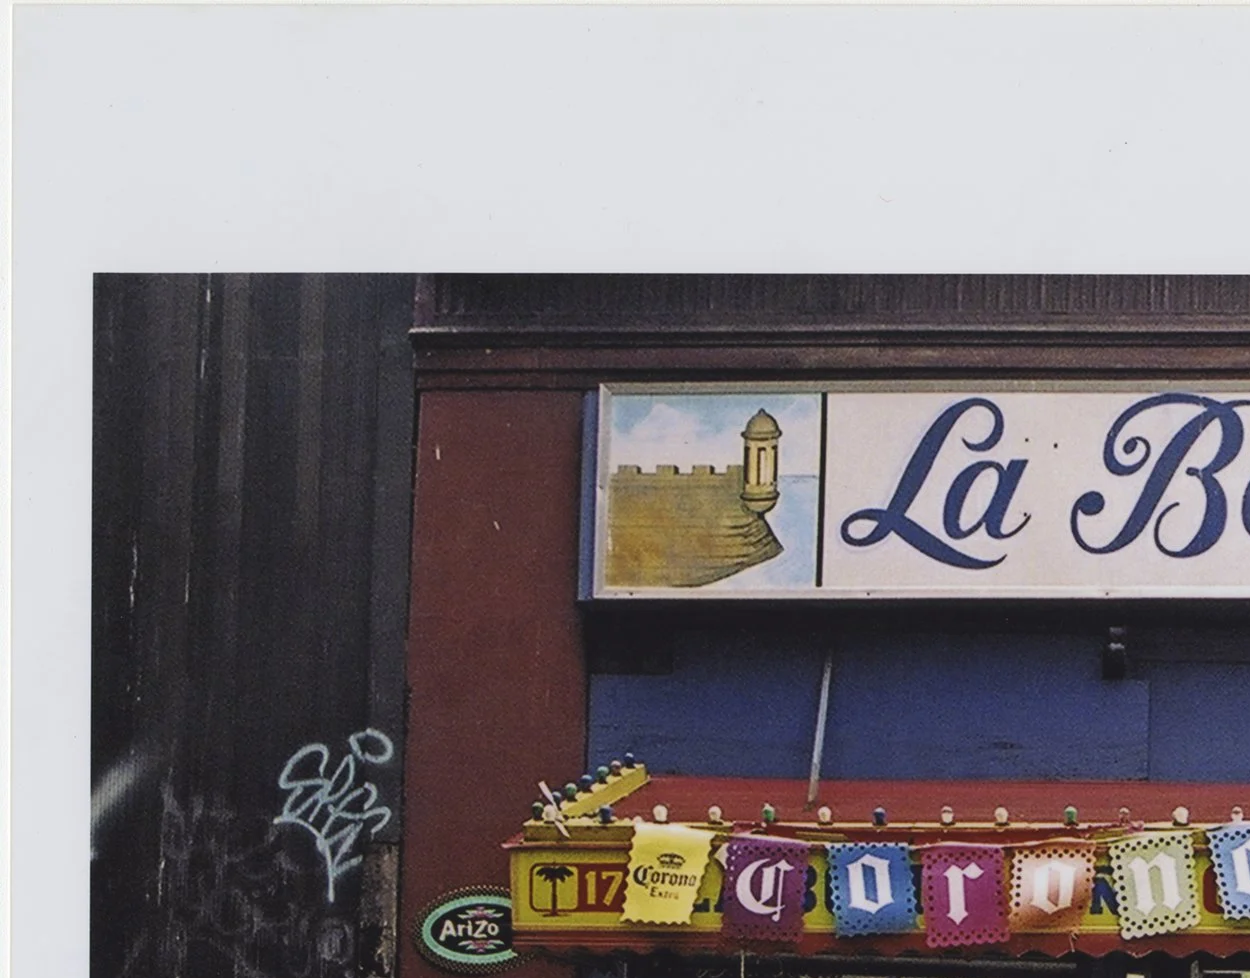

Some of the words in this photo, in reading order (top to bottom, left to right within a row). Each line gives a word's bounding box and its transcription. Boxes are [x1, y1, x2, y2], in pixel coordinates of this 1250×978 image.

[840, 397, 1031, 570] La
[633, 865, 697, 887] Corona
[649, 886, 680, 900] Extra
